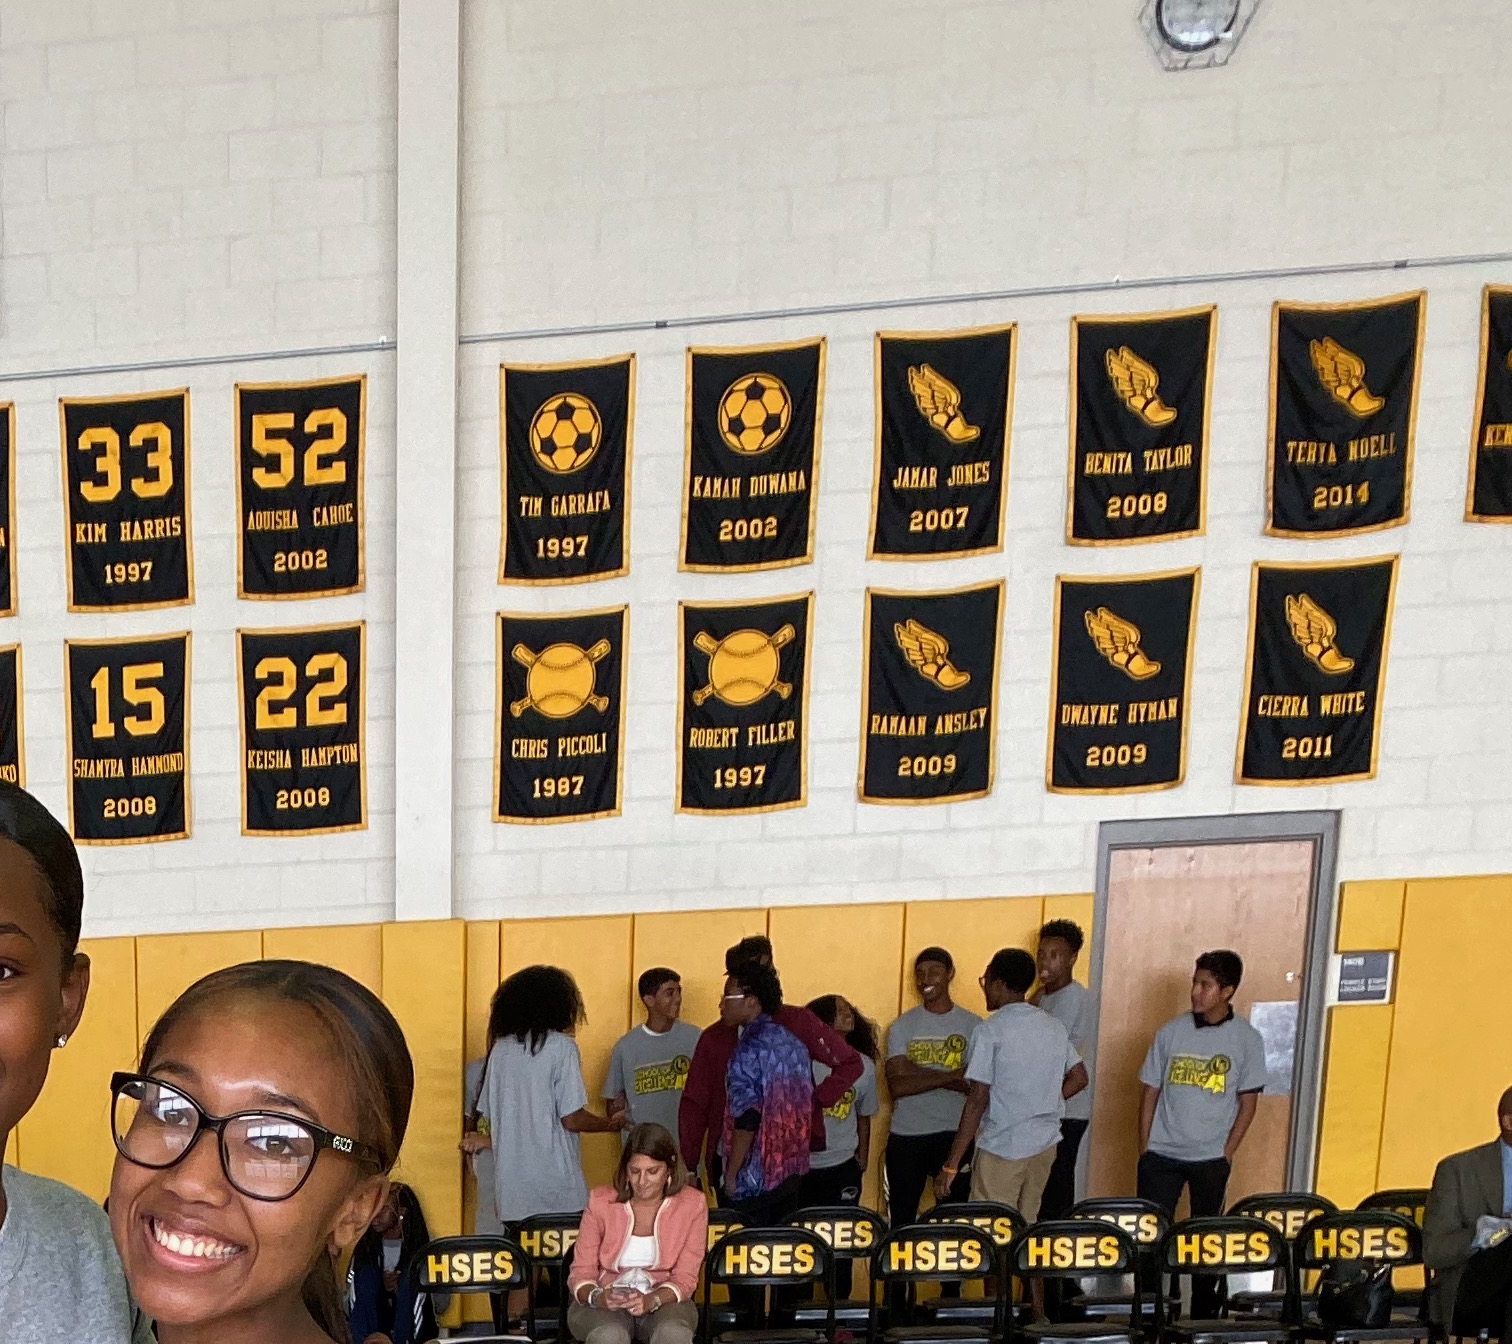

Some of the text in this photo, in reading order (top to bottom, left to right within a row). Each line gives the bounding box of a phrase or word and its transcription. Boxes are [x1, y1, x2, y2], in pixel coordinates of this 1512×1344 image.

[252, 407, 347, 488] 52
[1144, 444, 1192, 471] TAYLOR
[78, 422, 173, 502] 33
[893, 462, 989, 488] JAMAR JONES
[520, 490, 610, 516] TIM GARRAFA
[1107, 492, 1167, 518] 2008
[1314, 481, 1368, 509] 2014
[76, 516, 181, 543] KIM HARRIS
[720, 517, 777, 541] 2002
[910, 506, 968, 531] 2007
[537, 535, 588, 558] 1997
[105, 561, 152, 583] 1997
[274, 549, 327, 572] 2002
[91, 662, 165, 738] 15
[255, 653, 347, 729] 22
[1258, 691, 1365, 717] CIERRA WHITE
[1062, 704, 1119, 725] DWAYNE
[512, 733, 606, 758] CHRIS PICCOLI
[690, 720, 794, 748] ROBERT FILLER
[1282, 736, 1331, 758] 2011
[132, 752, 183, 776] HAMMOND
[248, 743, 358, 770] KEISHA HAMPTON
[899, 754, 956, 776] 2009
[1087, 744, 1146, 766] 2009
[534, 776, 584, 798] 1987
[715, 765, 766, 788] 1997
[104, 796, 156, 817] 2008
[277, 787, 329, 809] 2008
[890, 1239, 982, 1271] HSES
[1027, 1236, 1120, 1268] HSES
[1176, 1231, 1271, 1264] HSES
[1313, 1227, 1408, 1259] HSES
[427, 1250, 513, 1284] HSES
[725, 1243, 815, 1275] HSES
